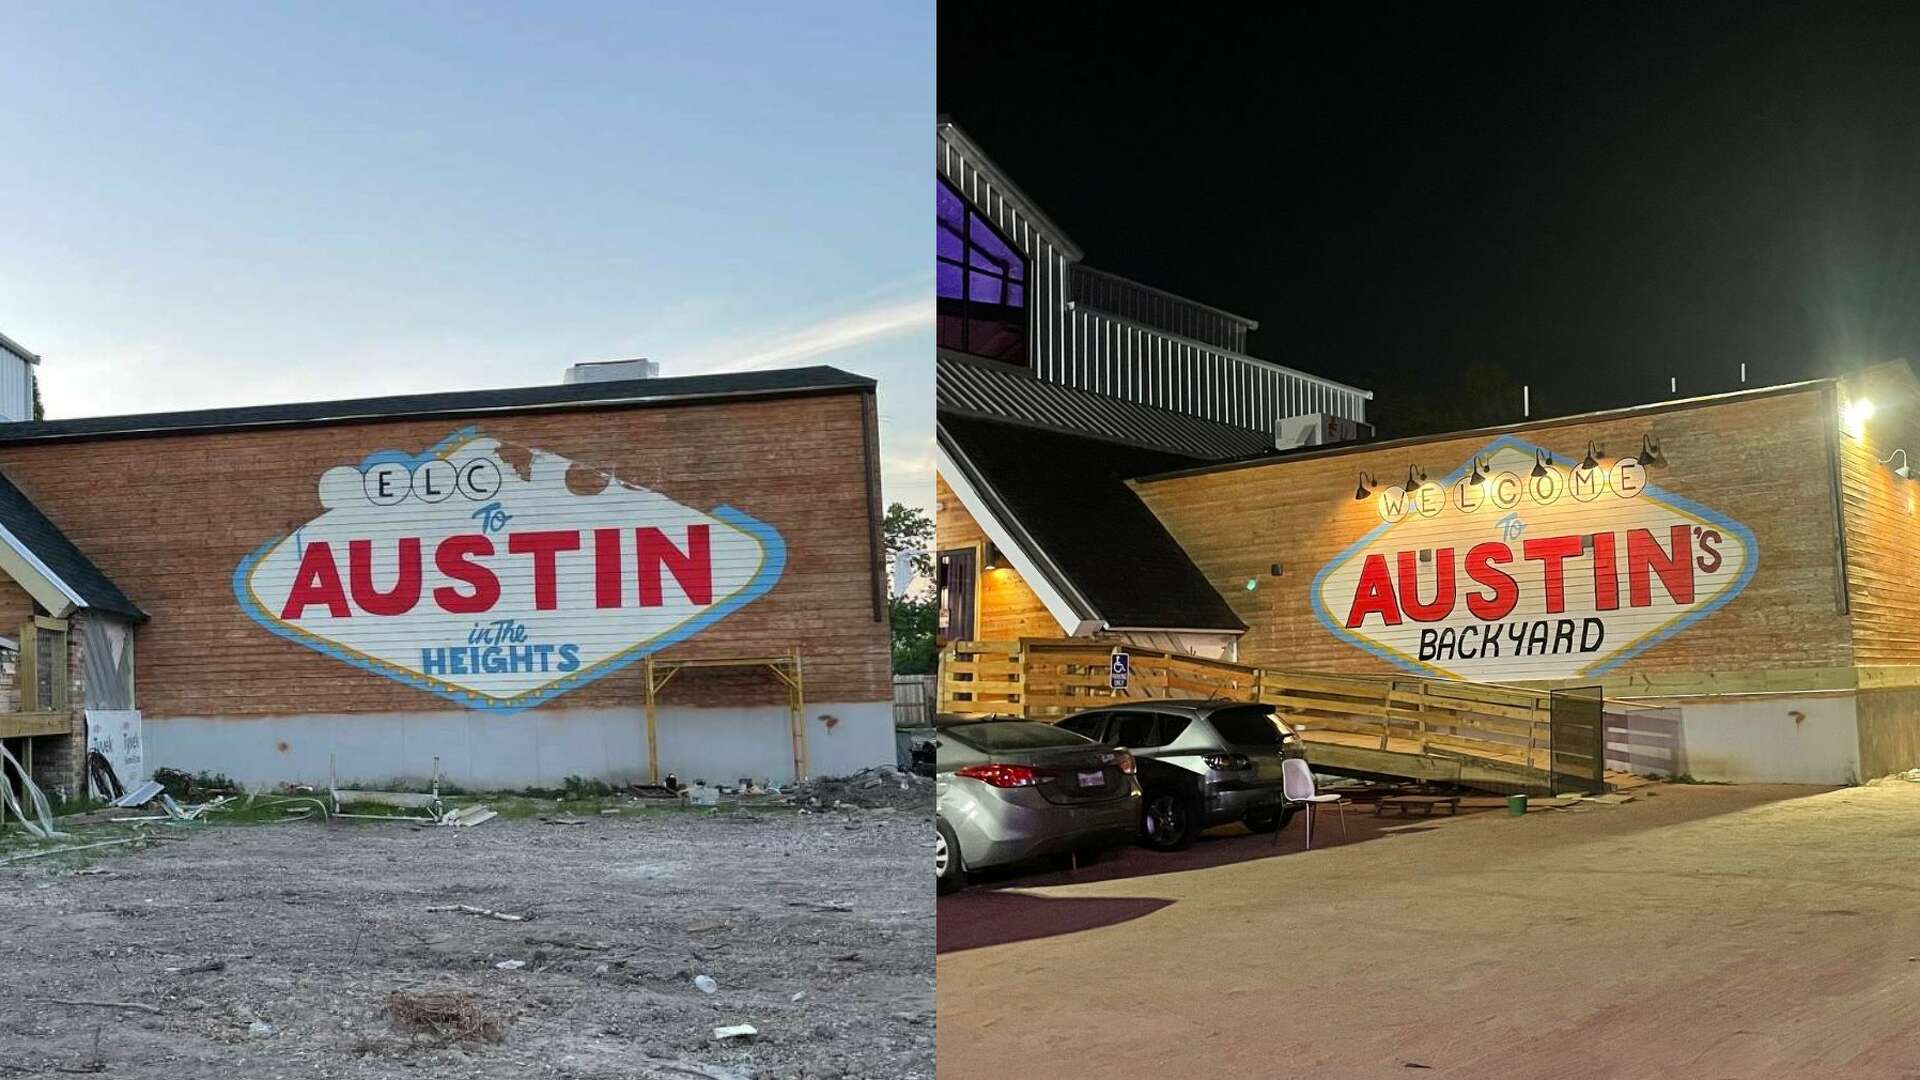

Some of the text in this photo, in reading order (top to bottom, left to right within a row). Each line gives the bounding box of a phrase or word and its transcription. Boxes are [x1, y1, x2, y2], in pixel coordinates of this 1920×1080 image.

[1384, 463, 1637, 517] WELCOME
[281, 524, 714, 619] AUSTIN
[1345, 524, 1723, 629] AUSTIN'S
[468, 622, 493, 645] in
[1418, 616, 1605, 661] BACKYARD
[422, 643, 582, 675] HEIGHTS
